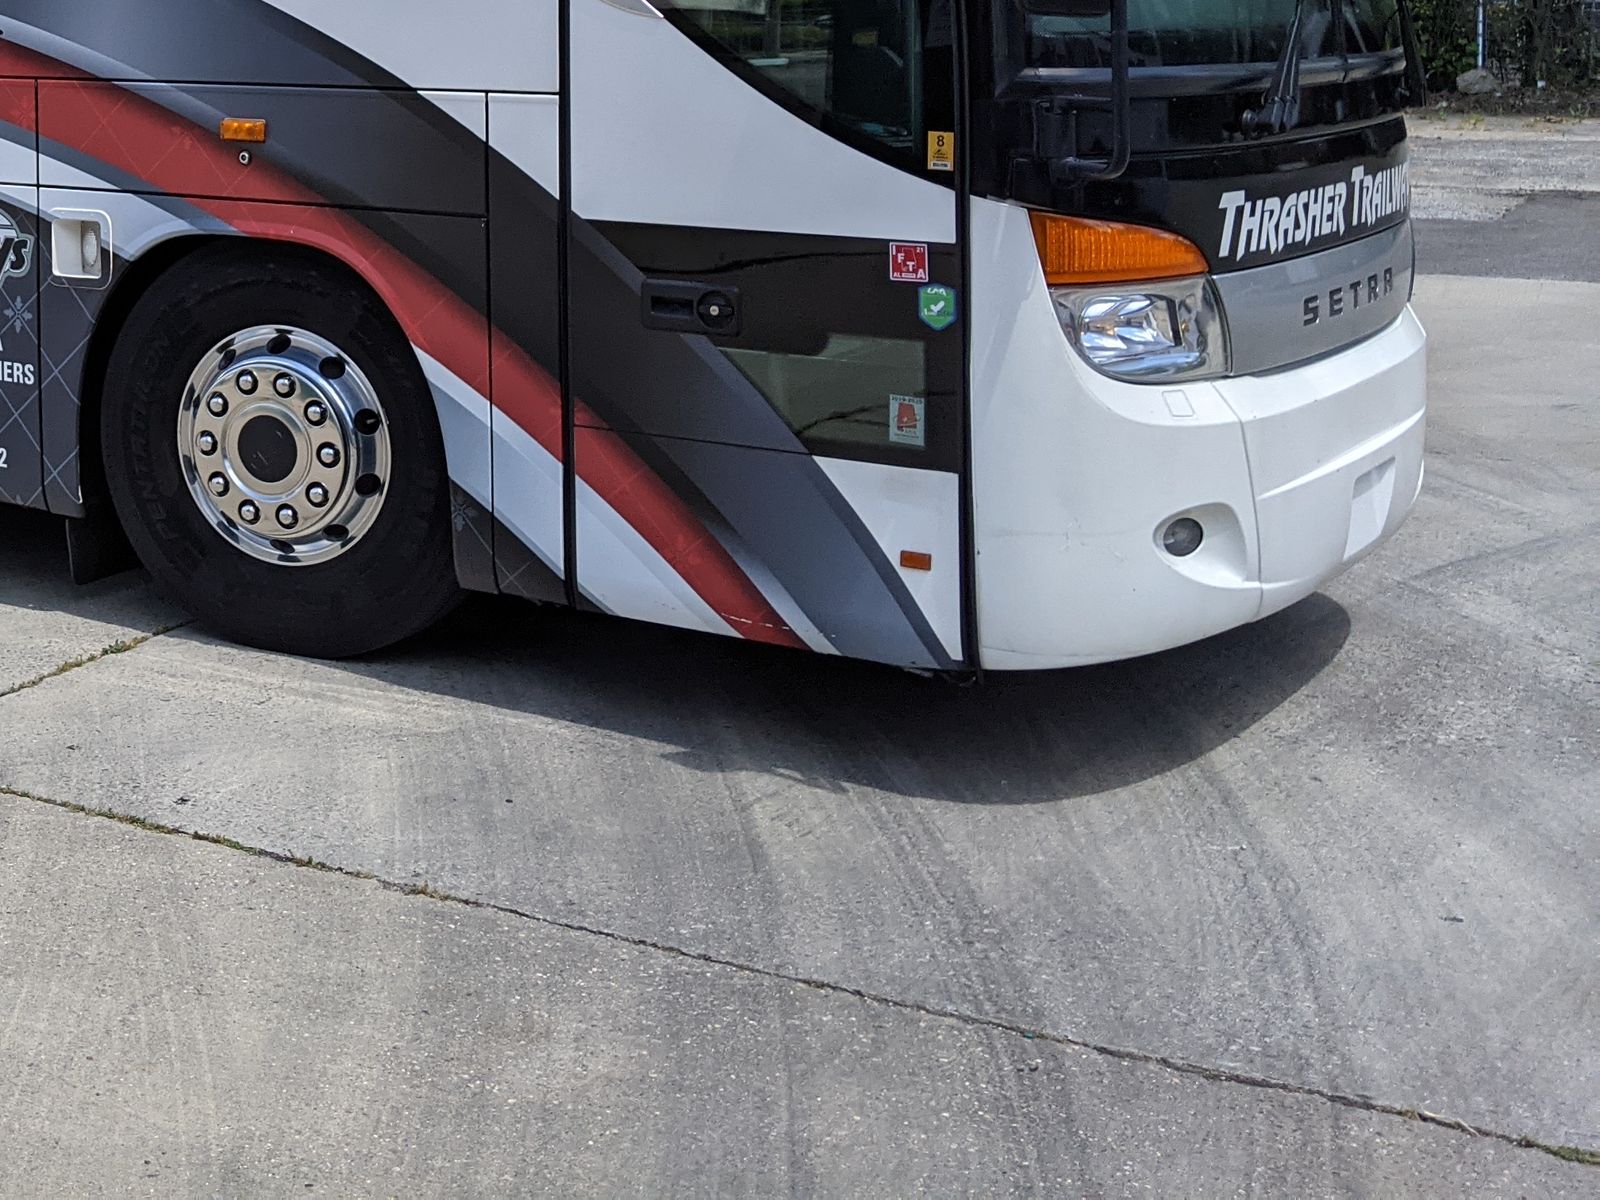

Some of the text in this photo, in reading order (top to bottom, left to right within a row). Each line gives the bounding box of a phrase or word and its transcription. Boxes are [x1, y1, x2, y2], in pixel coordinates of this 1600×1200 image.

[936, 135, 945, 147] 8
[1218, 161, 1409, 262] THRASHER TRAILWA
[1303, 266, 1393, 326] SETRA
